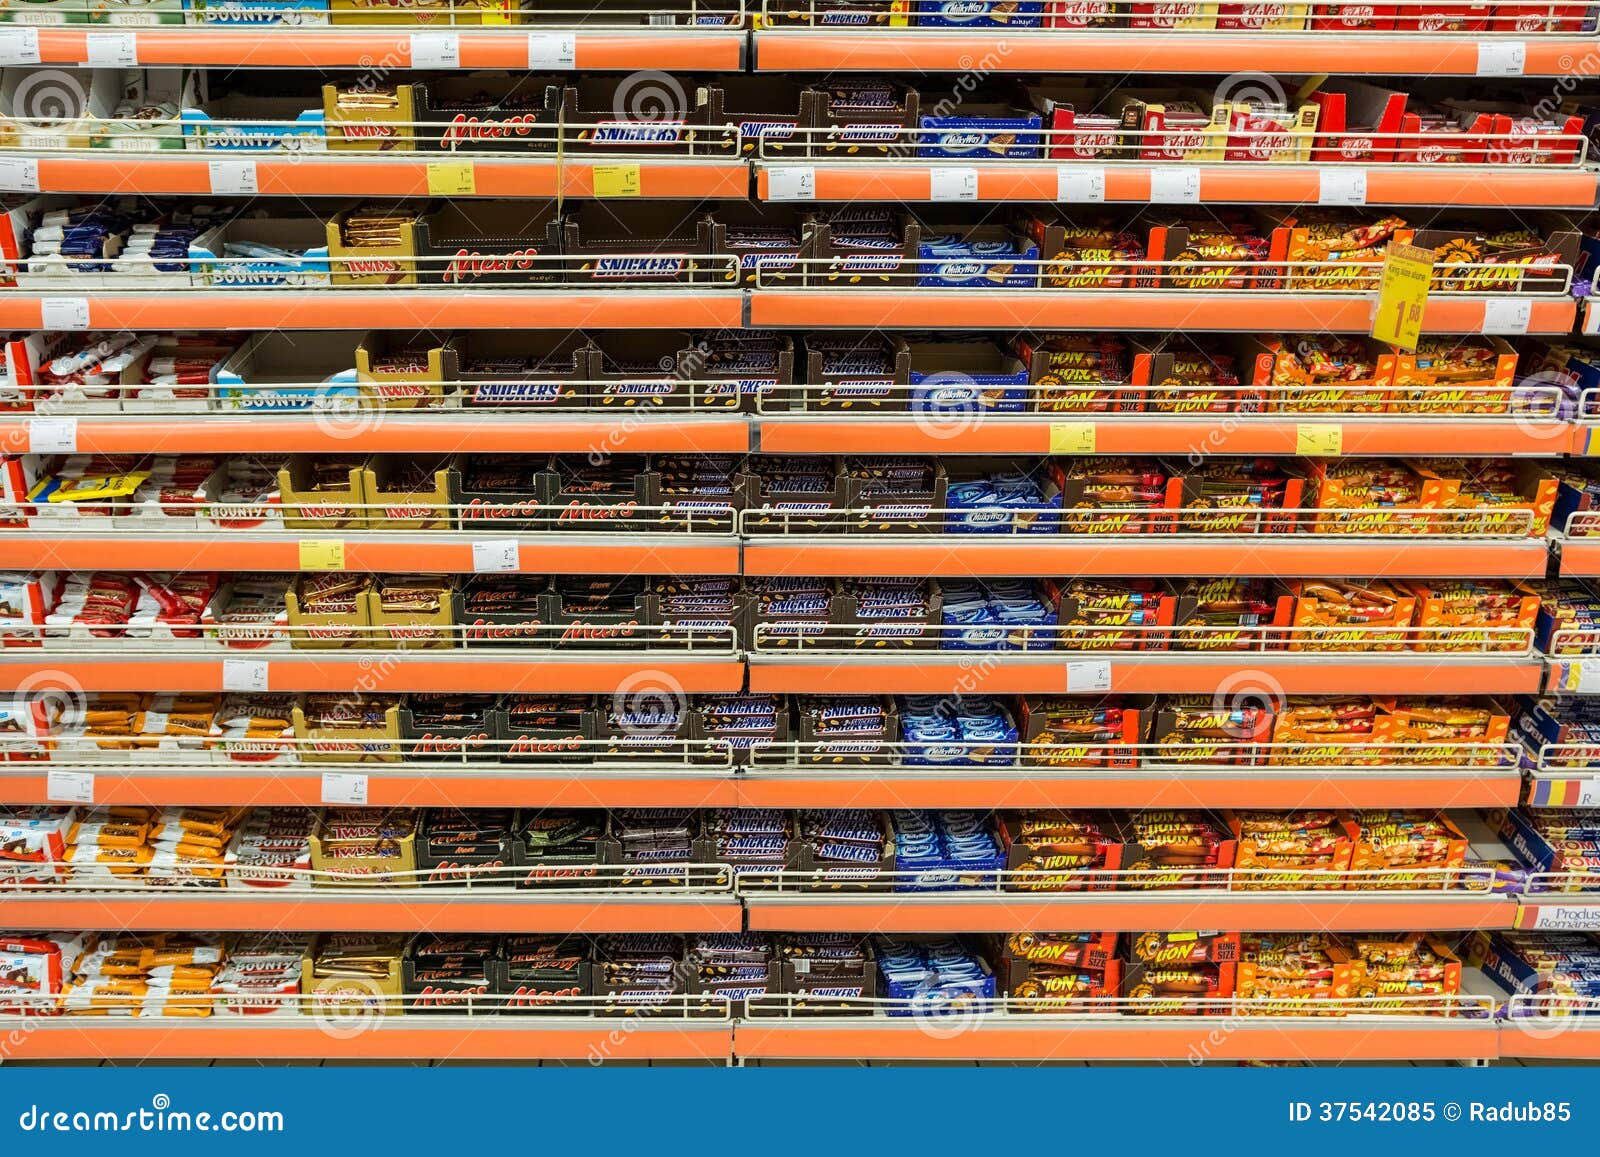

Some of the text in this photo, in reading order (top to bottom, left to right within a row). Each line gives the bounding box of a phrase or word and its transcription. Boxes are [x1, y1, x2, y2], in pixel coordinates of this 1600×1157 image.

[440, 113, 537, 149] Mars
[596, 122, 681, 142] SNICKERS
[740, 123, 797, 138] SNICKERS
[842, 124, 898, 139] SNICKERS
[443, 248, 537, 281] Mars
[598, 256, 683, 274] SNICKERS
[741, 254, 798, 268] SNICKERS
[845, 255, 899, 269] SNICKERS
[1137, 267, 1157, 279] KING
[1258, 268, 1277, 278] KING
[1135, 278, 1156, 289] SIZE
[1256, 279, 1277, 289] SIZE
[474, 383, 562, 401] SNICKERS
[618, 381, 673, 394] SNICKERS
[719, 381, 777, 394] SNICKERS
[836, 381, 892, 395] SNICKERS
[1121, 391, 1140, 402] KING
[1119, 402, 1140, 412] SIZE
[462, 498, 540, 521] Mars
[558, 501, 638, 525] Mars
[875, 504, 930, 518] SNICKERS
[466, 618, 541, 640] Mars
[561, 620, 638, 644] Mars
[770, 621, 824, 634] SNICKERS
[870, 623, 923, 636] SNICKERS
[717, 701, 775, 714] SNICKERS
[824, 706, 881, 718] SNICKERS
[621, 712, 679, 726] SNICKERS
[413, 733, 488, 755] Mars
[507, 734, 585, 757] Mars
[719, 735, 774, 749] SNICKERS
[829, 739, 880, 752] SNICKERS
[728, 820, 787, 833] SNICKERS
[823, 828, 881, 842] SNICKERS
[728, 836, 788, 849] SNICKERS
[820, 844, 880, 863] SNICKERS
[428, 861, 504, 881] Mars
[525, 863, 597, 885] Mars
[637, 864, 687, 876] SNICKERS
[1556, 907, 1600, 921] Produs
[1217, 942, 1236, 950] KING
[1217, 951, 1235, 960] SIZE
[235, 961, 293, 972] BOUNTY
[412, 986, 488, 1006] Mars
[507, 987, 582, 1008] Mars
[716, 988, 767, 1001] SNICKERS
[812, 988, 861, 1000] SNICKERS
